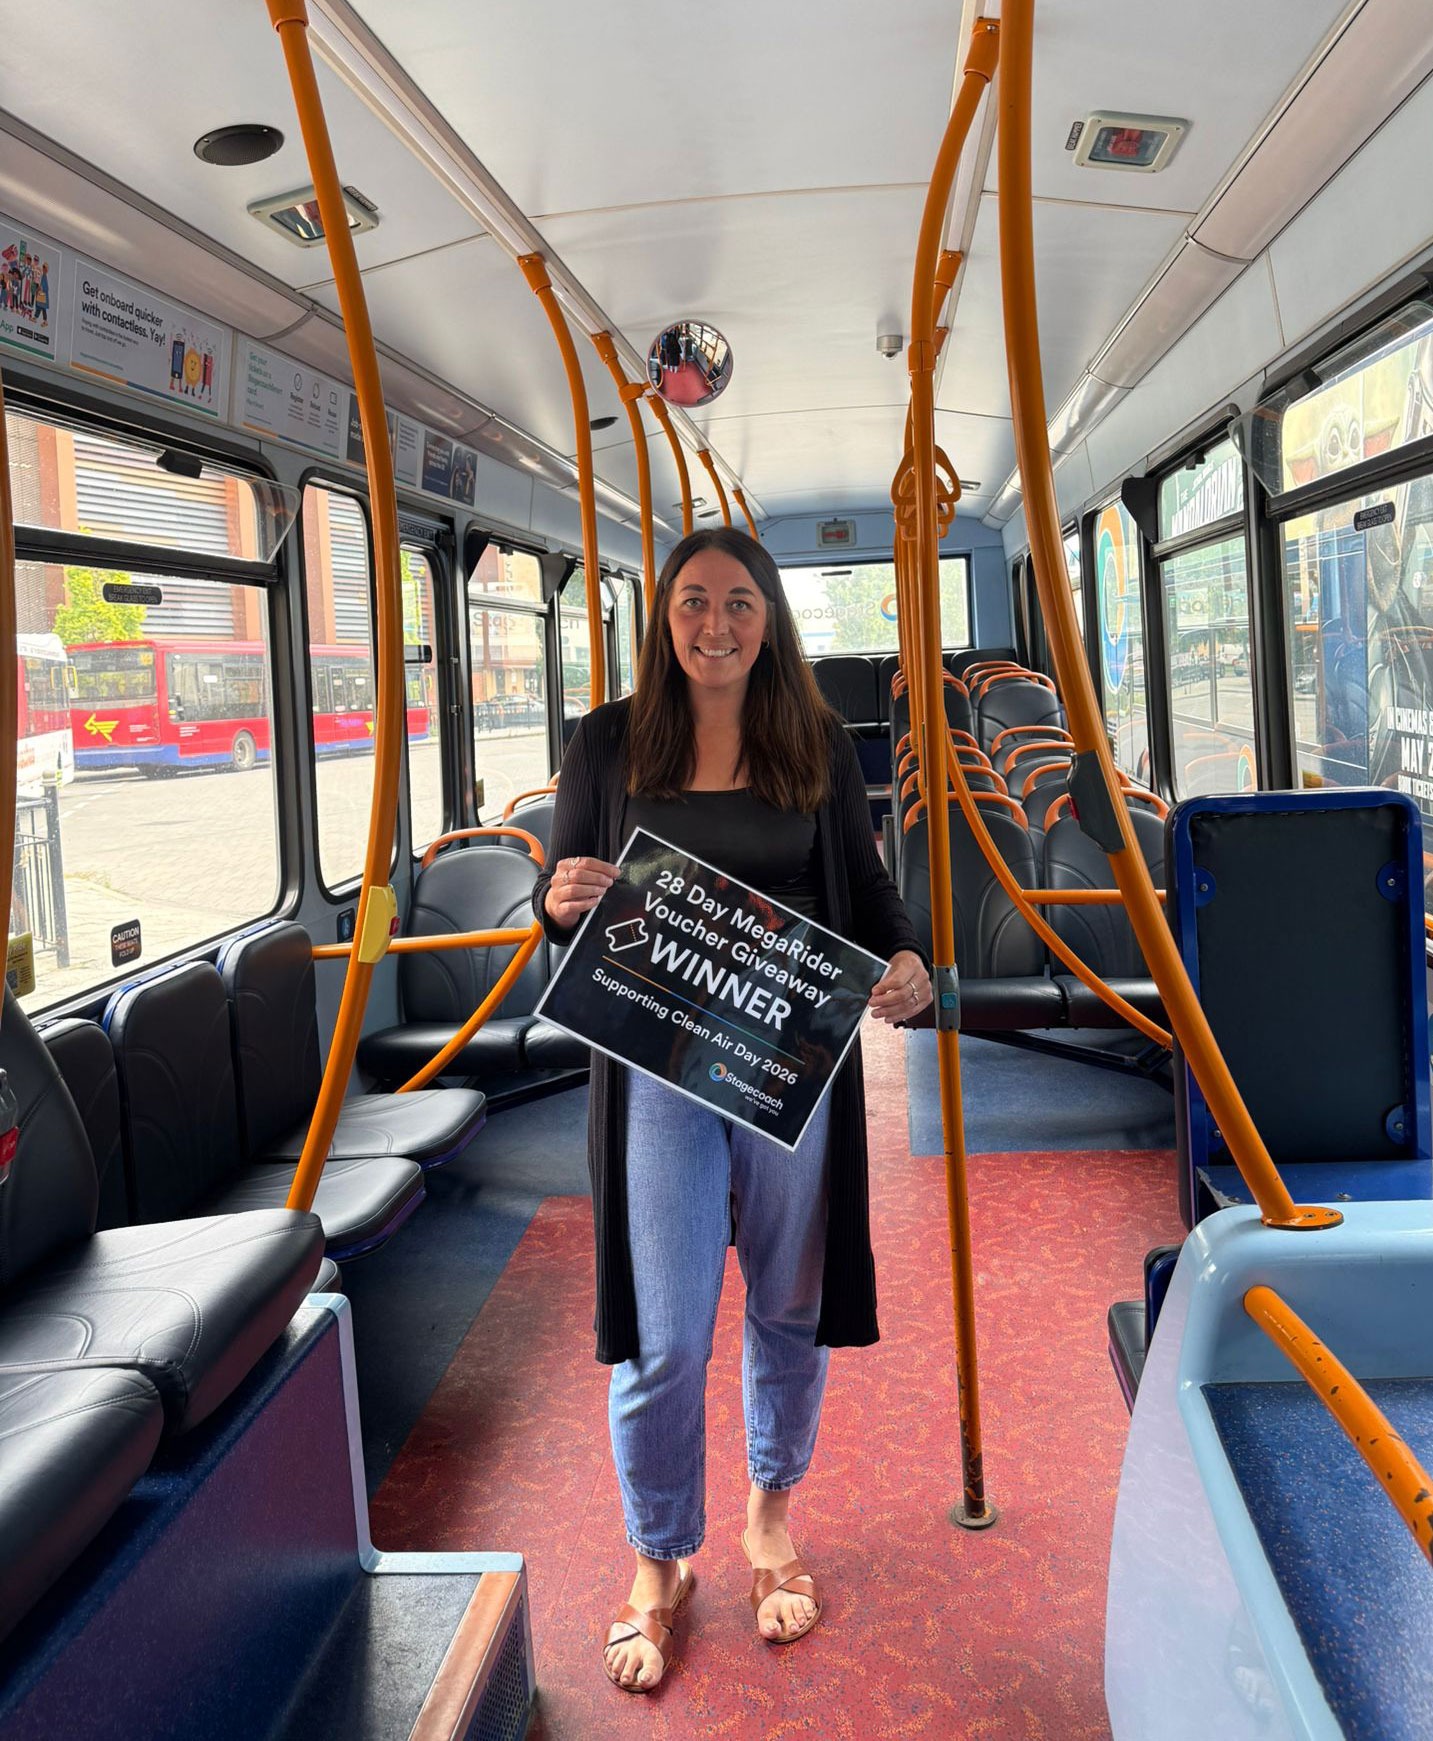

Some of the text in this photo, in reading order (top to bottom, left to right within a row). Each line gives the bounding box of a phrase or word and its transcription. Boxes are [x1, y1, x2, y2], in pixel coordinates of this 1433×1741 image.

[81, 301, 101, 319] with
[101, 310, 149, 339] contactless.
[149, 327, 167, 347] Yay!
[82, 281, 164, 328] Get onboard quicker
[1387, 706, 1395, 731] IN
[1396, 707, 1428, 735] CINEMAS
[1401, 736, 1424, 775] MAY
[112, 926, 139, 944] CAUTION
[655, 870, 844, 981] 28 Day MegaRider
[644, 891, 832, 1009] Voucher Giveaway
[650, 932, 792, 1032] WINNER
[592, 967, 800, 1086] Supporting Clean Air Day 2026
[725, 1072, 785, 1111] Stagecoach
